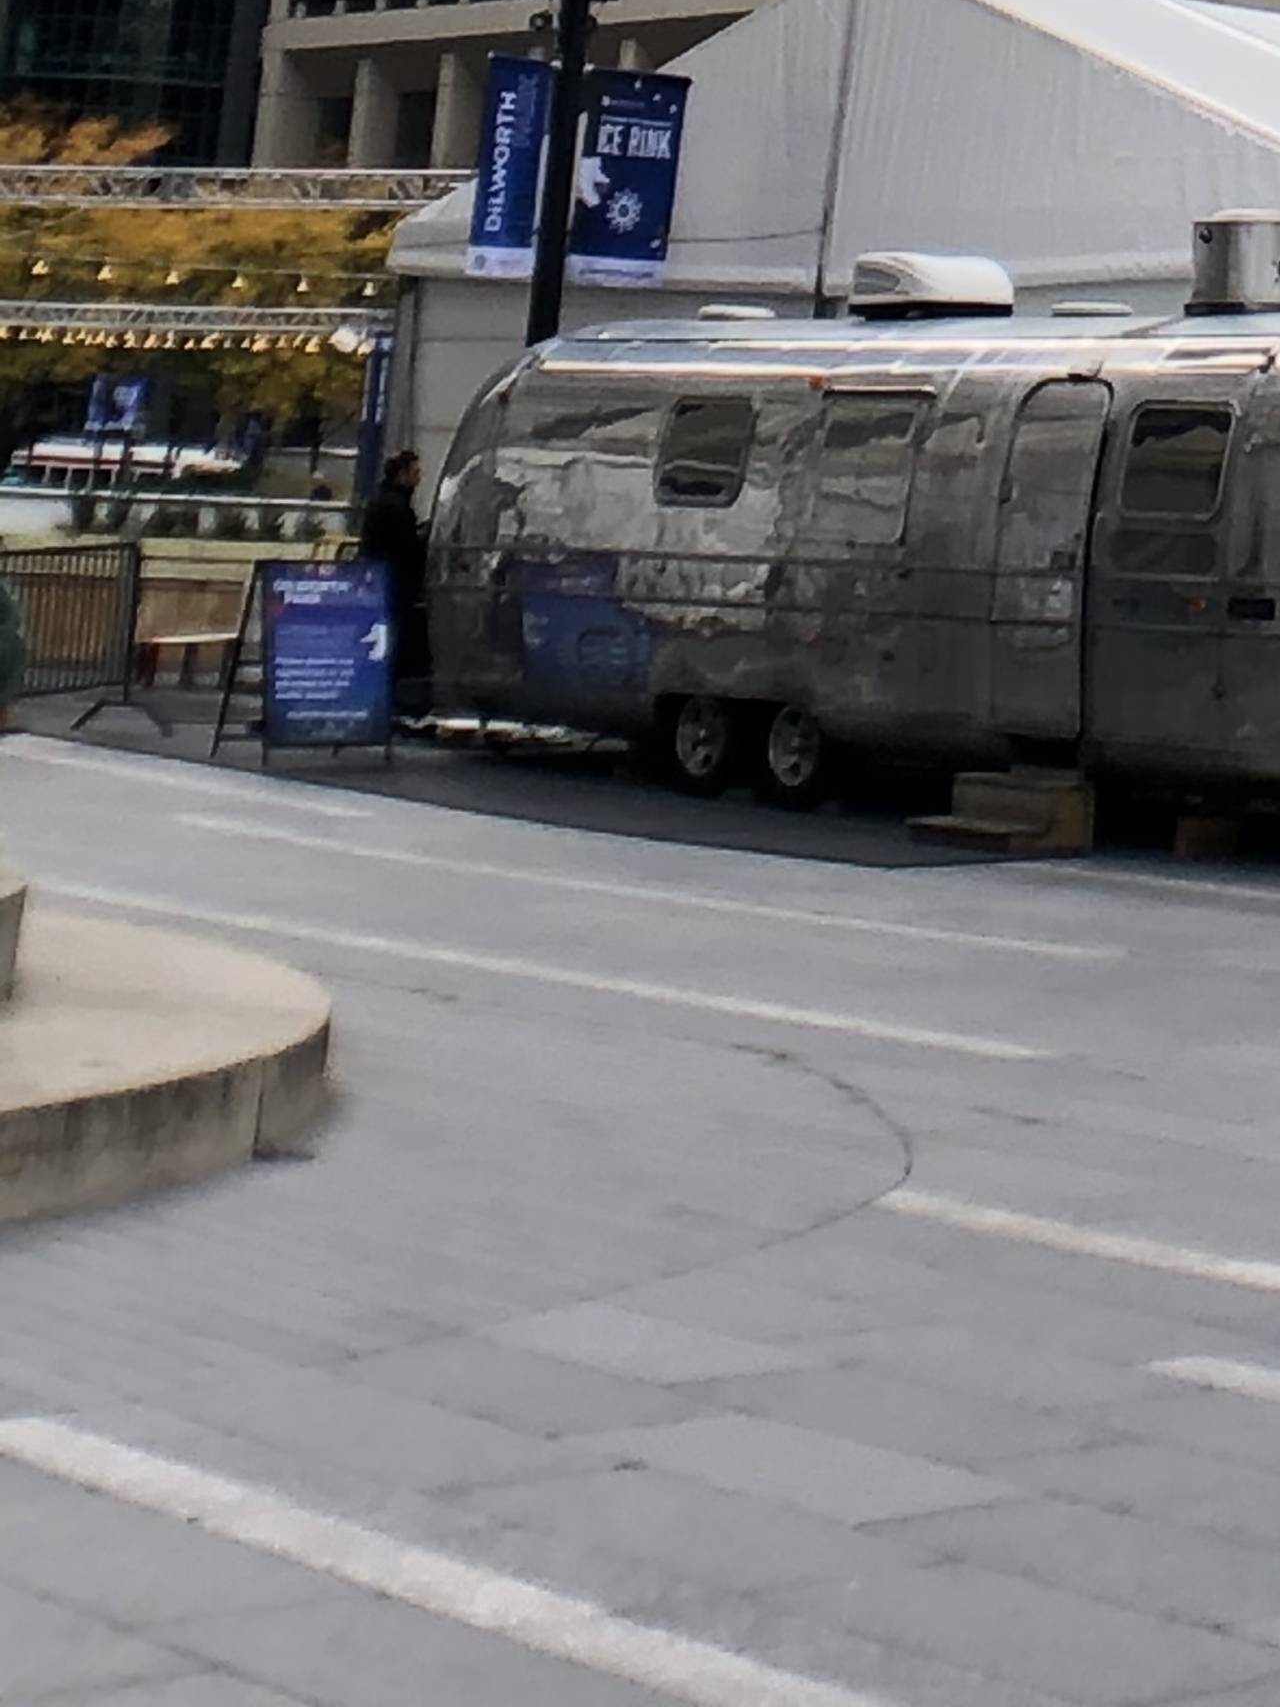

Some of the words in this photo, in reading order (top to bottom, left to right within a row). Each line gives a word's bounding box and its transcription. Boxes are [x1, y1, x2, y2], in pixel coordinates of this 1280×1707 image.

[484, 91, 518, 232] DILWORTH
[596, 122, 626, 156] ICE
[626, 126, 672, 160] RINK
